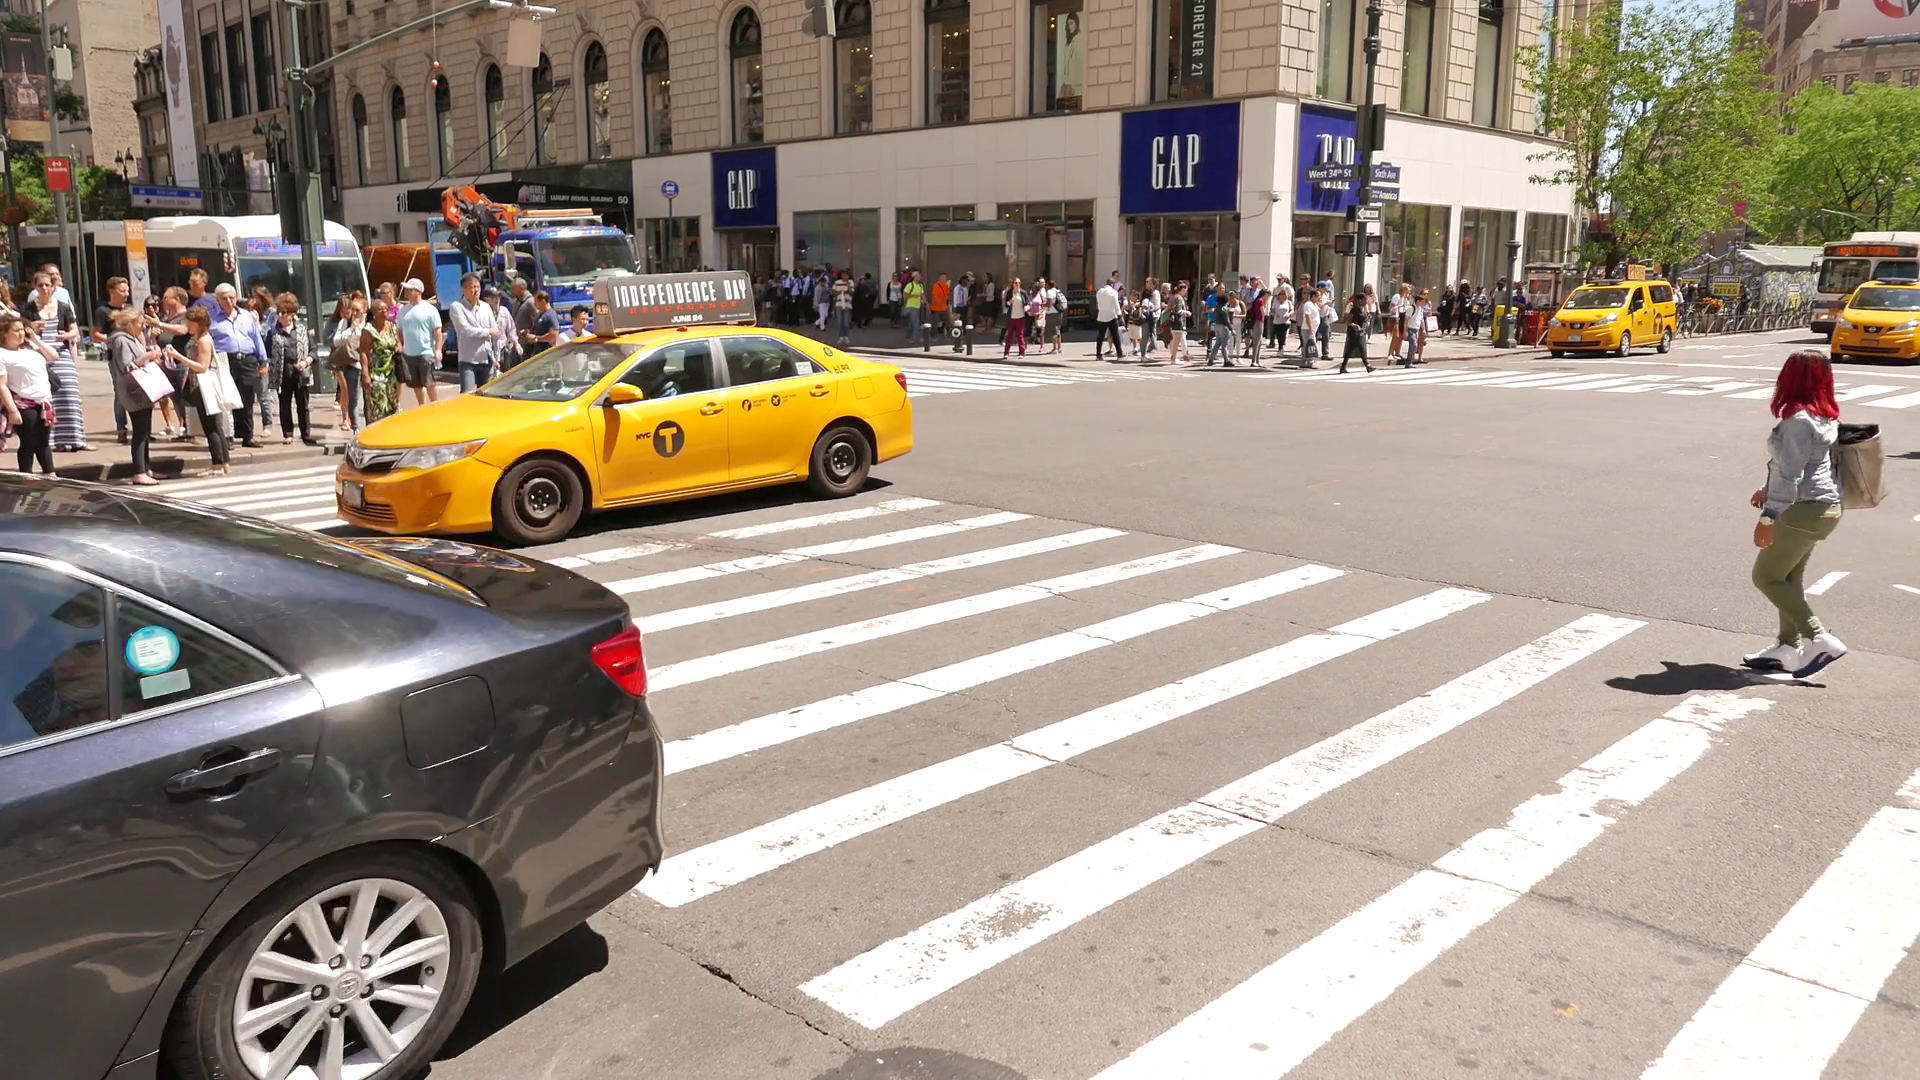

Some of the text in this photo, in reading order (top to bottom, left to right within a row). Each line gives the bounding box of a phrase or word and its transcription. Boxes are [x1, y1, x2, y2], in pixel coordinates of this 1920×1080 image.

[1191, 63, 1204, 76] 21
[1152, 134, 1200, 190] GAP
[1309, 168, 1352, 178] West 34th St
[1375, 169, 1396, 179] Sixth Ave
[728, 169, 755, 210] GAP
[1379, 190, 1398, 200] Americas
[618, 196, 628, 204] 50
[613, 279, 747, 308] INDEPENDENCE DAY
[630, 301, 739, 315] RESURGENCE
[671, 314, 703, 323] JUNE 24
[636, 432, 651, 441] NYC
[659, 427, 678, 453] T
